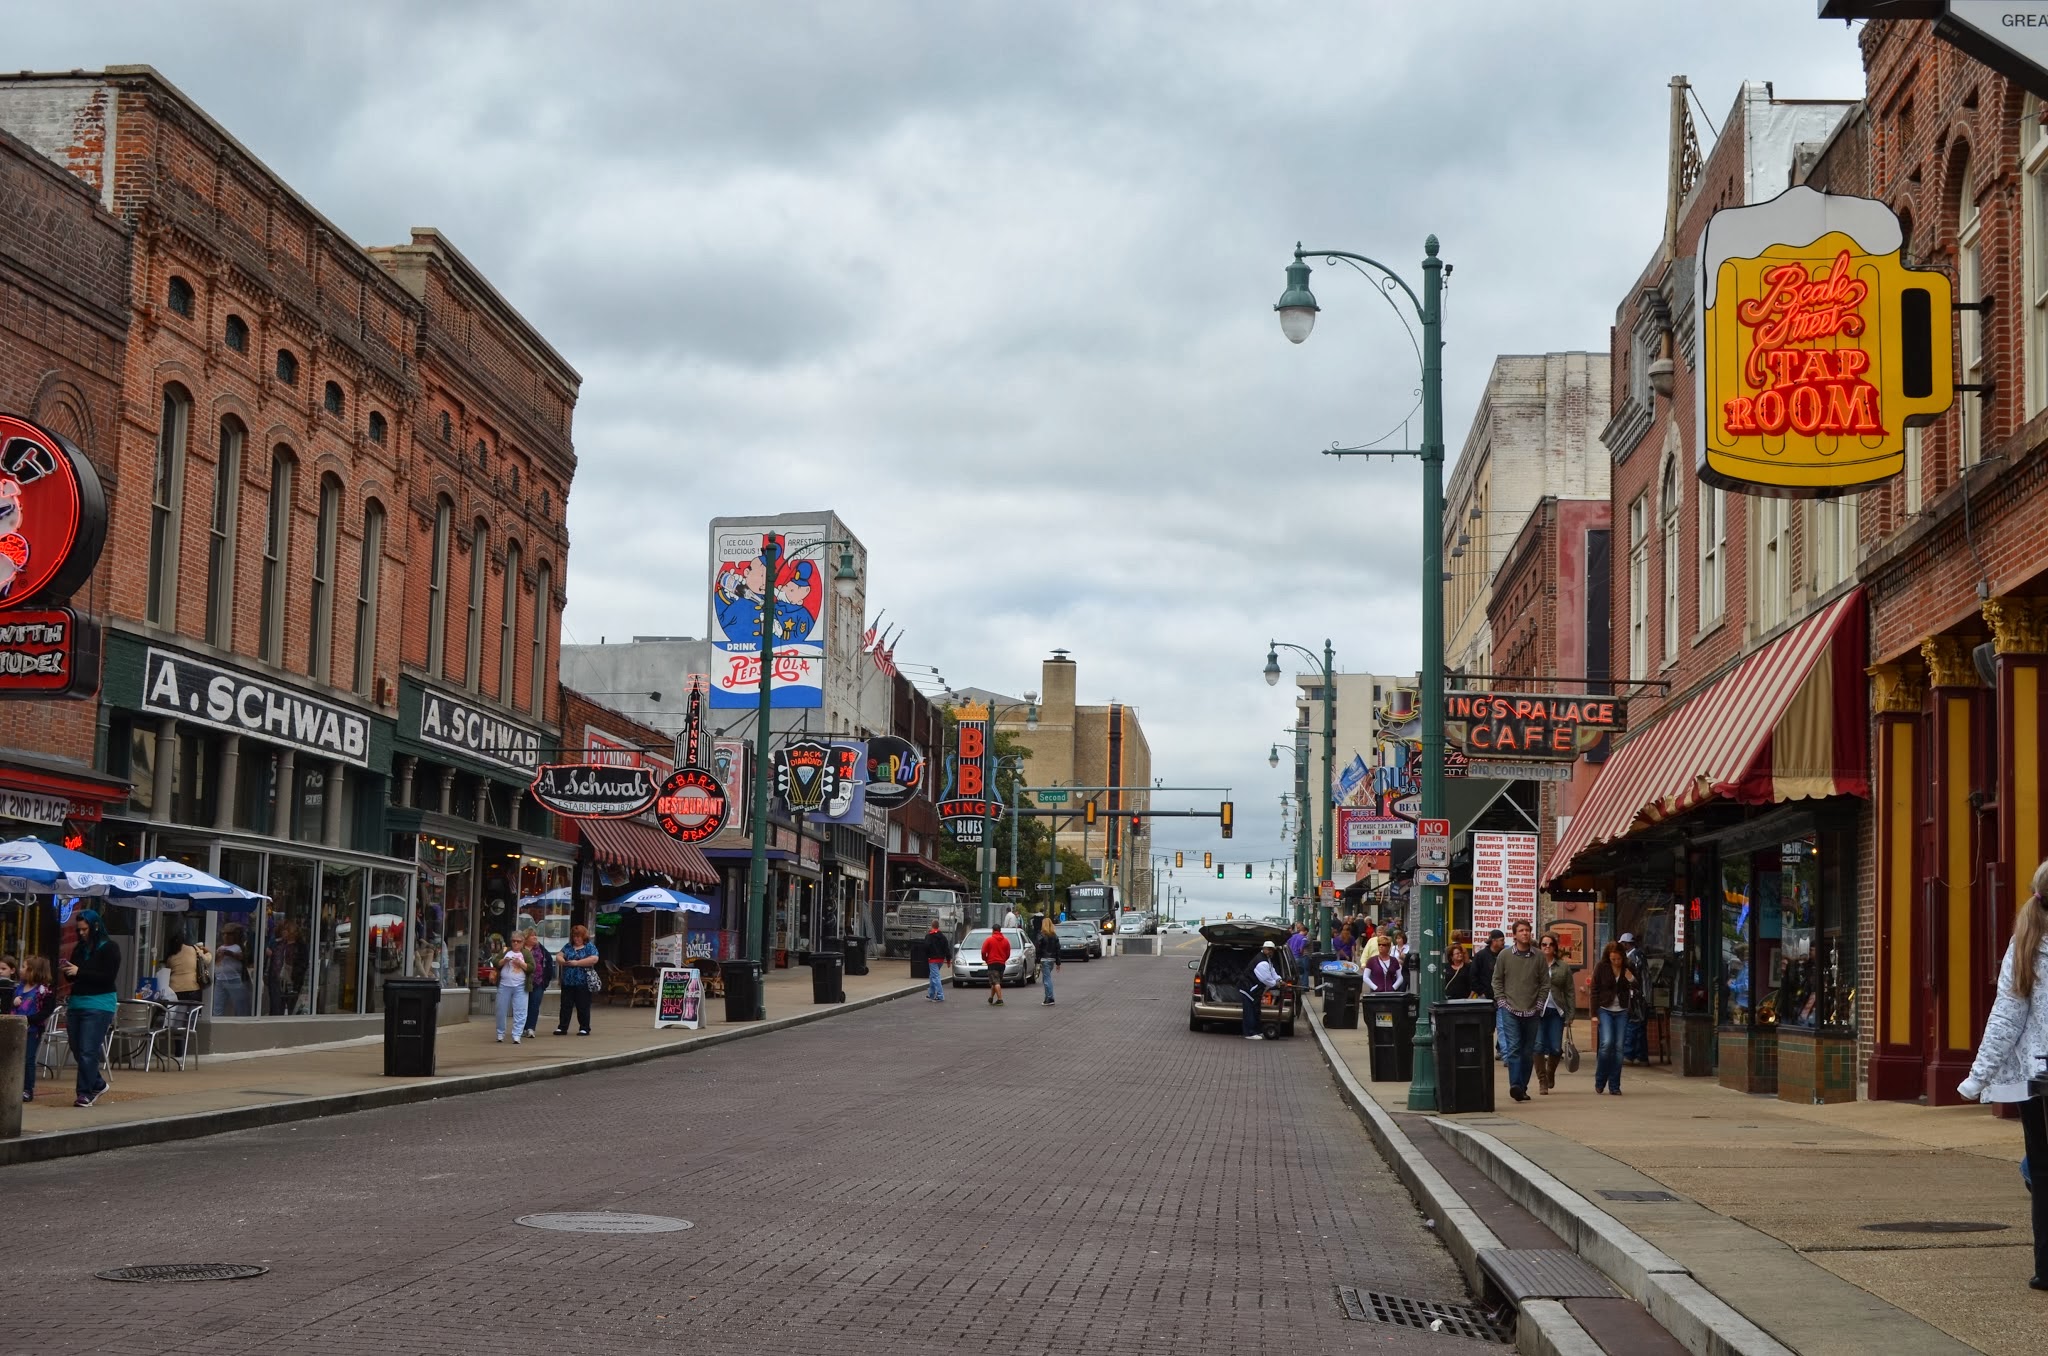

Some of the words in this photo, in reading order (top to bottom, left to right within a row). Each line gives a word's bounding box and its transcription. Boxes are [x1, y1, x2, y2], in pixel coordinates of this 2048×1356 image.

[1738, 249, 1868, 326] Beale
[1769, 350, 1866, 389] TAP
[1726, 384, 1878, 431] ROOM
[727, 643, 757, 651] DRINK
[1516, 702, 1614, 724] PALACE
[960, 727, 984, 758] B
[1471, 725, 1573, 750] CAFE
[790, 757, 823, 767] DIAMOND
[792, 750, 821, 758] BLACK
[864, 750, 927, 786] emphis
[1471, 765, 1490, 776] AIR
[1494, 765, 1569, 779] CONDITIONED
[564, 769, 651, 797] Schwab
[675, 773, 709, 788] BAR
[959, 764, 983, 795] B
[10, 795, 32, 818] 2ND
[34, 799, 68, 823] PLACE
[558, 800, 615, 813] ESTABLISHED
[617, 802, 634, 812] 1876
[658, 797, 724, 815] RESTAURANT
[662, 817, 679, 834] 159
[682, 816, 719, 841] BEALE
[957, 820, 982, 834] BLUES
[1424, 822, 1443, 834] NO
[1080, 888, 1093, 896] PARTY
[1093, 888, 1104, 896] BUS
[662, 999, 684, 1007] SILLY
